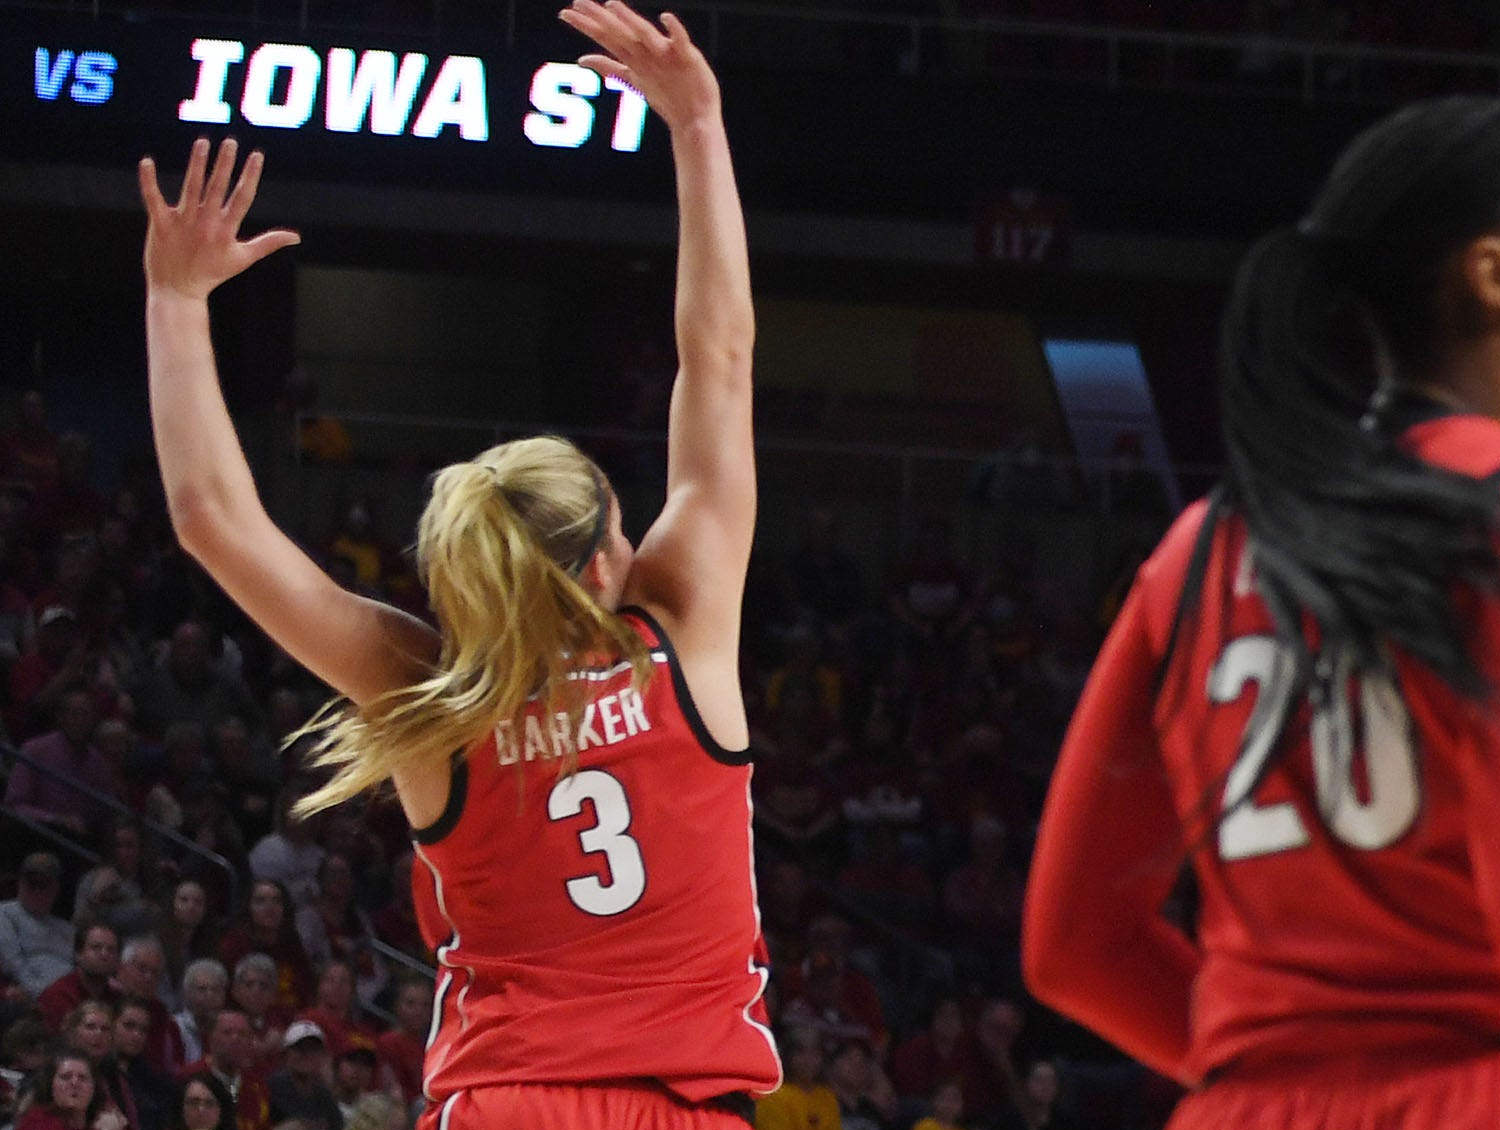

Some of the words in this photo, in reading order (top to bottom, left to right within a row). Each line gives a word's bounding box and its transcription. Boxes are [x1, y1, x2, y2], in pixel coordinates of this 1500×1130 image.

[34, 46, 118, 105] VS
[178, 38, 489, 141] IOWA
[1206, 634, 1420, 861] 20
[546, 768, 647, 917] 3
